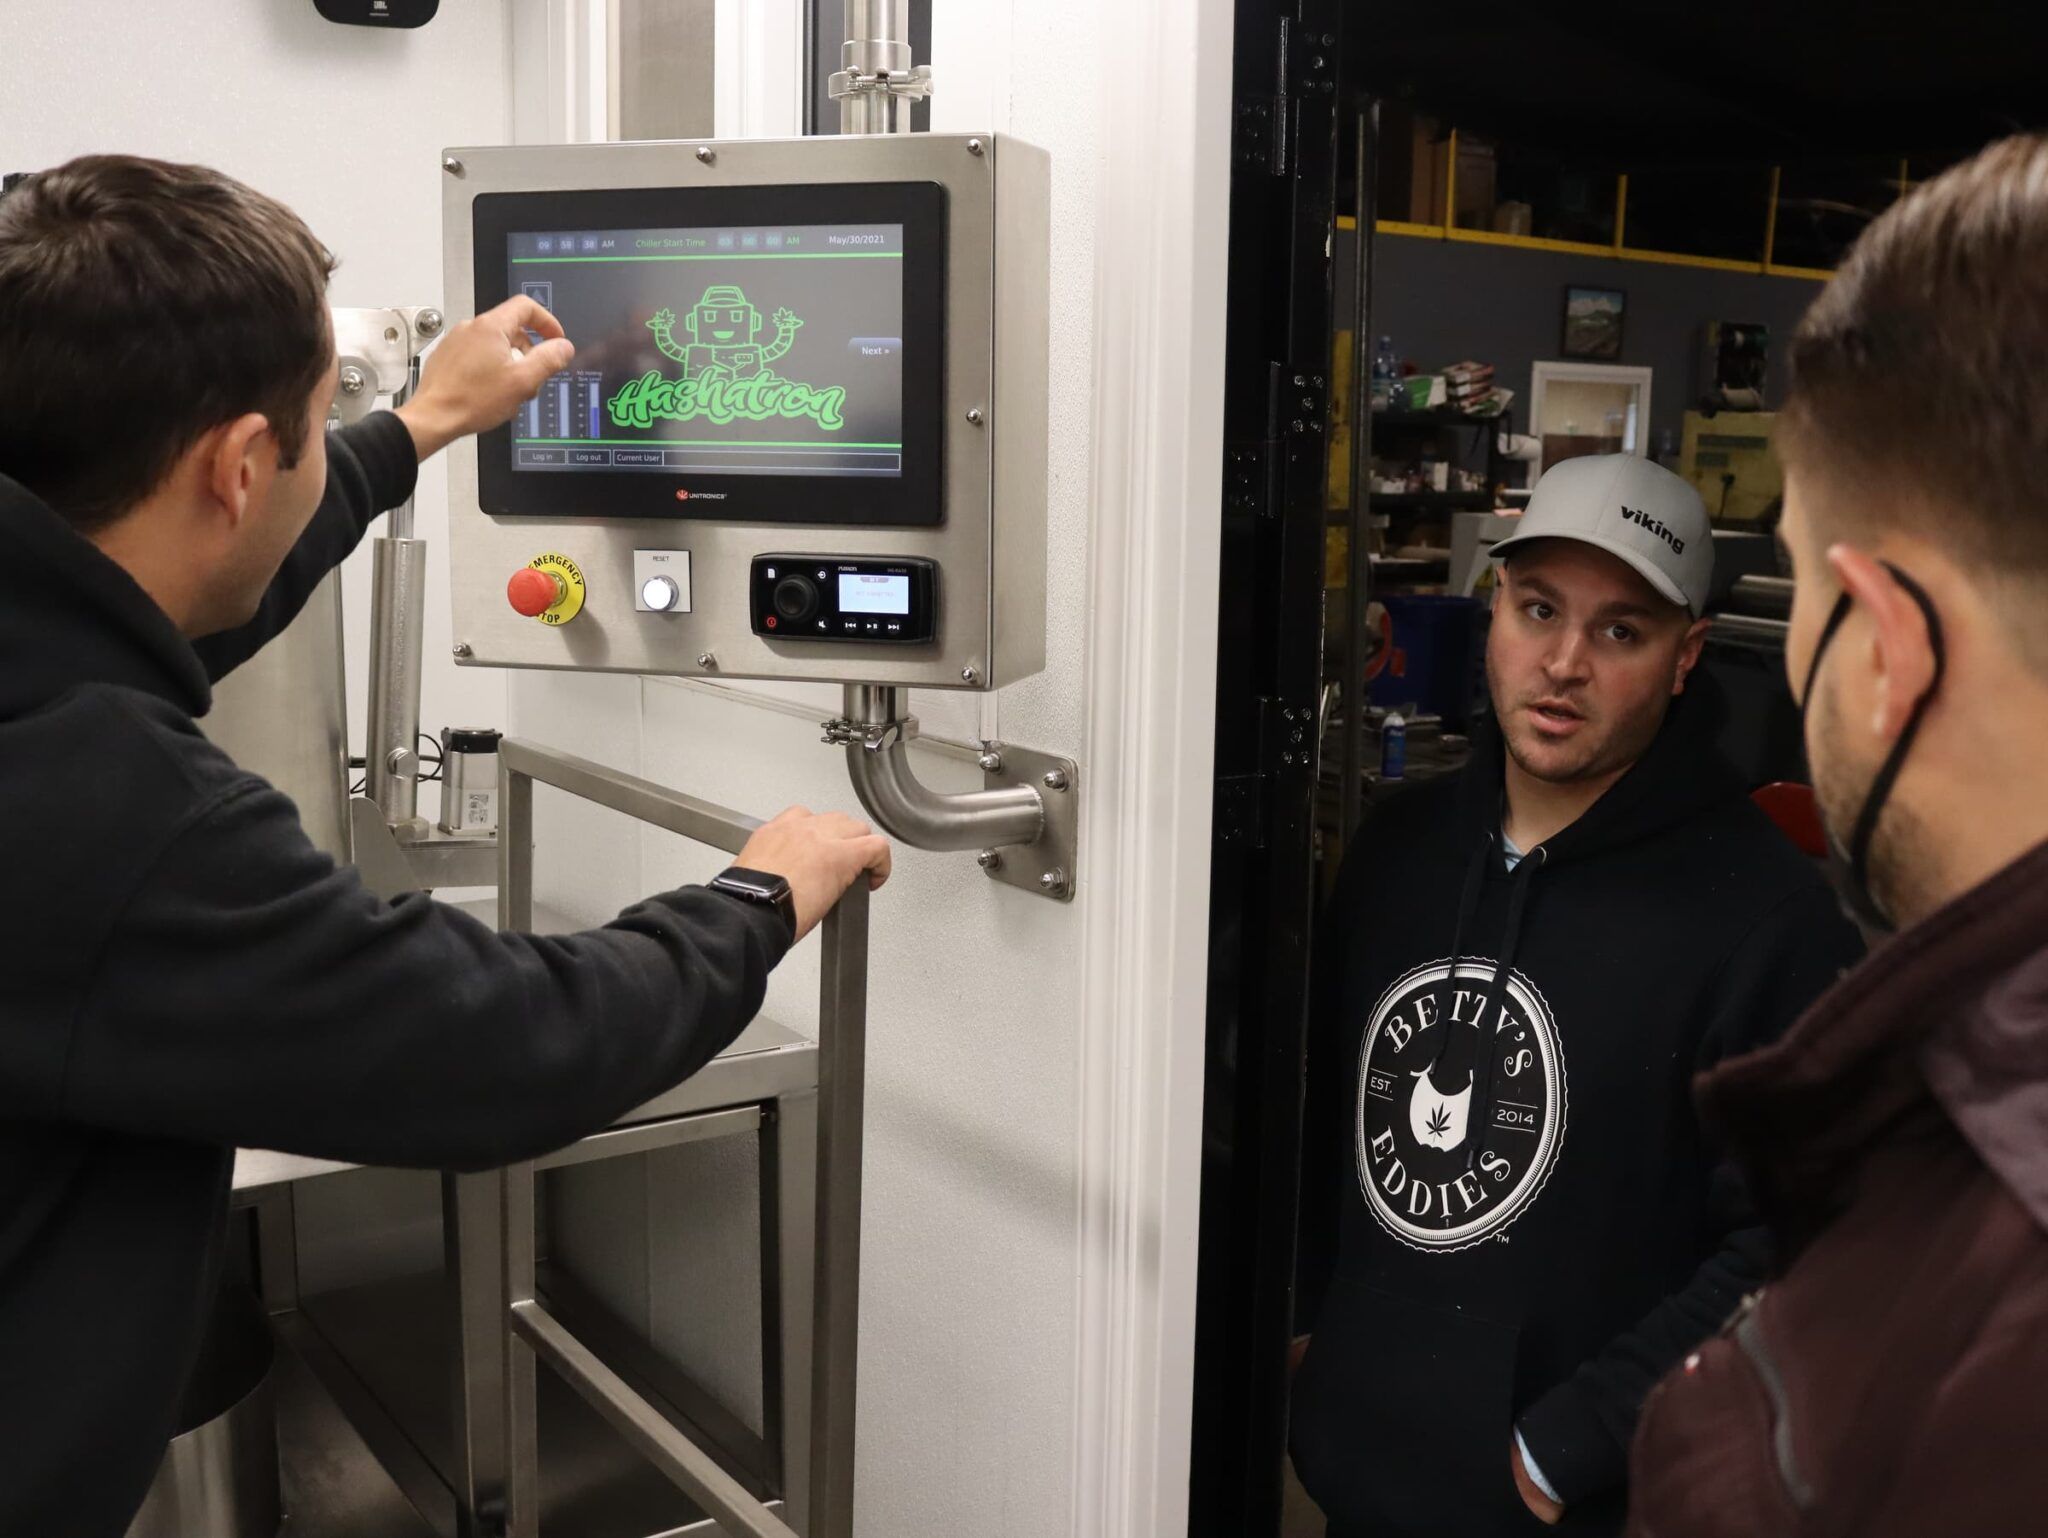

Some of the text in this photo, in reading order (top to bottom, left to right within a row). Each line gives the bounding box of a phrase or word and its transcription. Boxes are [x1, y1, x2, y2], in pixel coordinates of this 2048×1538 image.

[635, 237, 706, 249] Chiller Start Time
[828, 235, 885, 246] May/30/2021
[862, 346, 882, 355] Next
[608, 369, 846, 430] Hashatron
[532, 453, 545, 462] Log
[576, 453, 602, 462] Log out
[617, 454, 660, 463] Current User
[1621, 505, 1685, 555] viking
[537, 612, 560, 623] TOP
[1370, 1076, 1393, 1094] EST.
[1496, 1109, 1535, 1125] 2014
[1371, 1125, 1511, 1219] EDDIES
